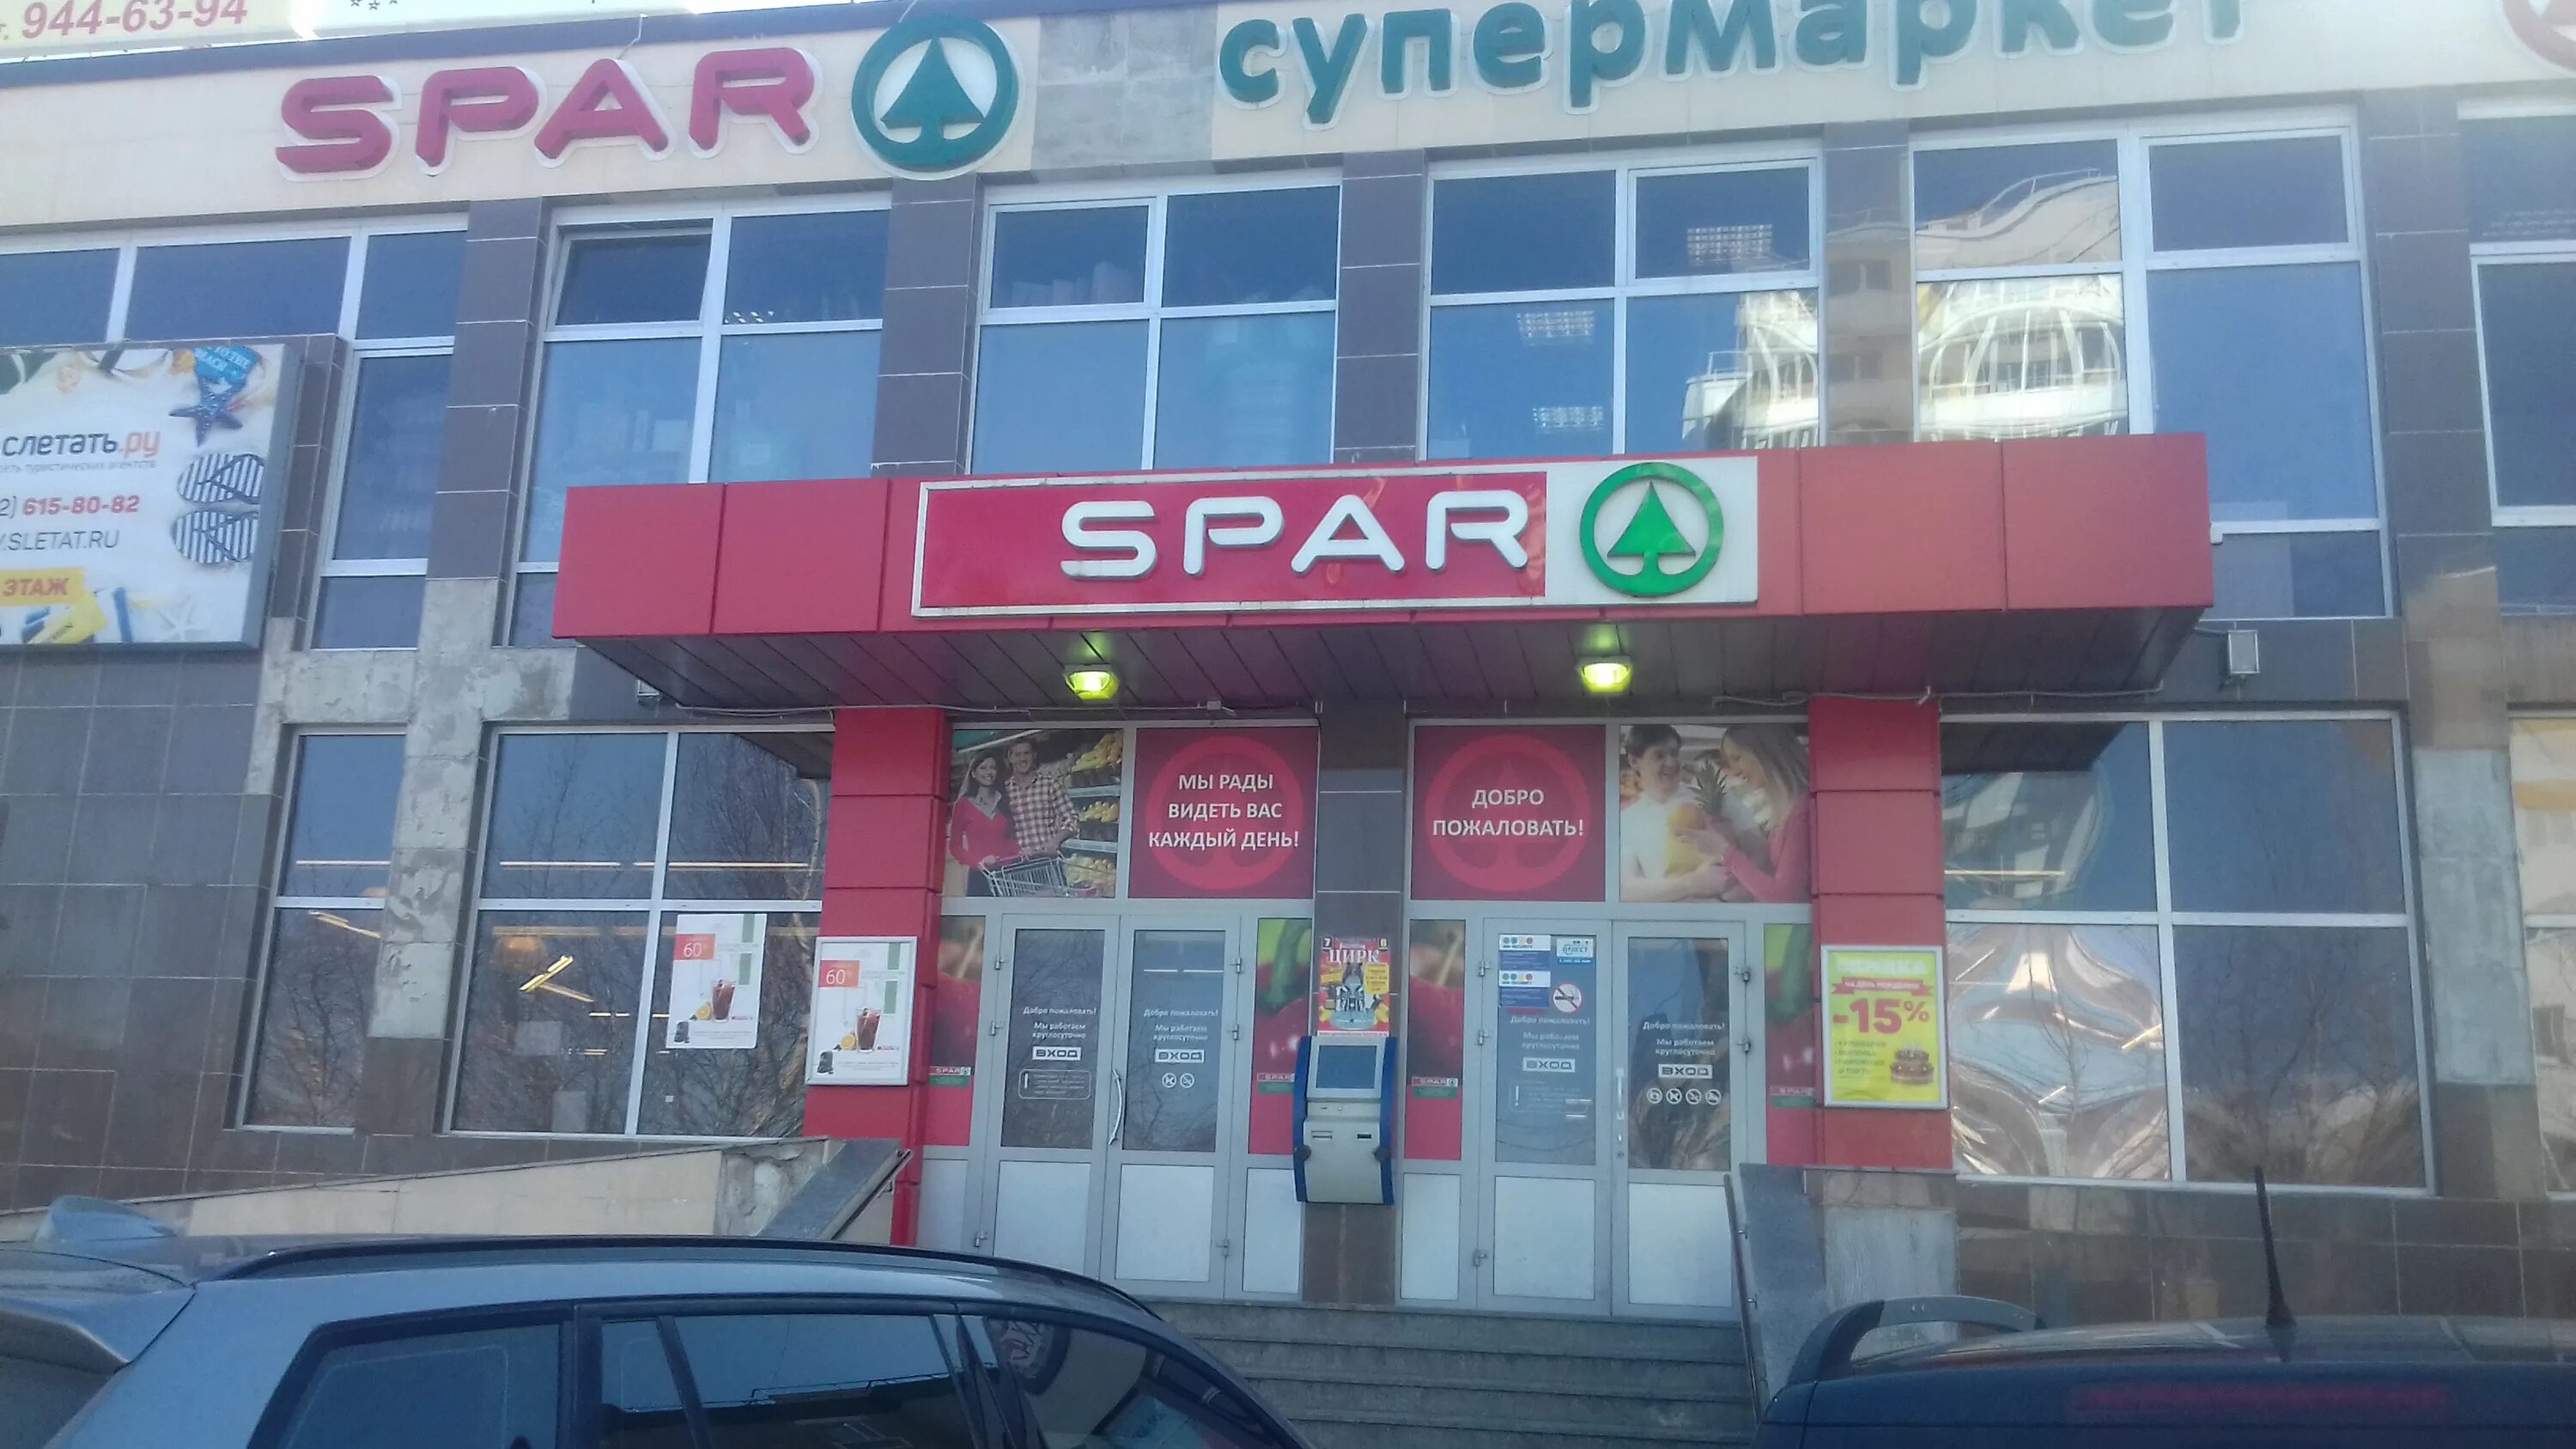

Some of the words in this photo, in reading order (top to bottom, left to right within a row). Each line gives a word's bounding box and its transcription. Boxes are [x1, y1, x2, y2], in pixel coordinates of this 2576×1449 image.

[22, 0, 247, 39] 944-63-94
[276, 47, 816, 174] SPAR
[3, 431, 161, 459] слетать.ру
[23, 495, 140, 515] 615-80-82
[0, 529, 120, 551] .SLETAT.RU
[1060, 489, 1528, 578] SPAR
[3, 578, 70, 597] ЭТАЖ
[1179, 774, 1212, 790] МЫ
[1219, 774, 1273, 792] РАДЫ
[1471, 789, 1545, 809] ДОБРО
[1169, 803, 1241, 821] ВИДЕТЬ
[1247, 803, 1283, 819] ВАС
[1432, 819, 1584, 837] ПОЖАЛОВАТЬ!
[1149, 828, 1236, 850] КАЖДЫЙ
[1241, 831, 1299, 850] ДЕНЬ!
[1329, 948, 1380, 965] ЦИРК
[1158, 1051, 1202, 1060] ВХОД
[1662, 1067, 1709, 1075] ВХОД
